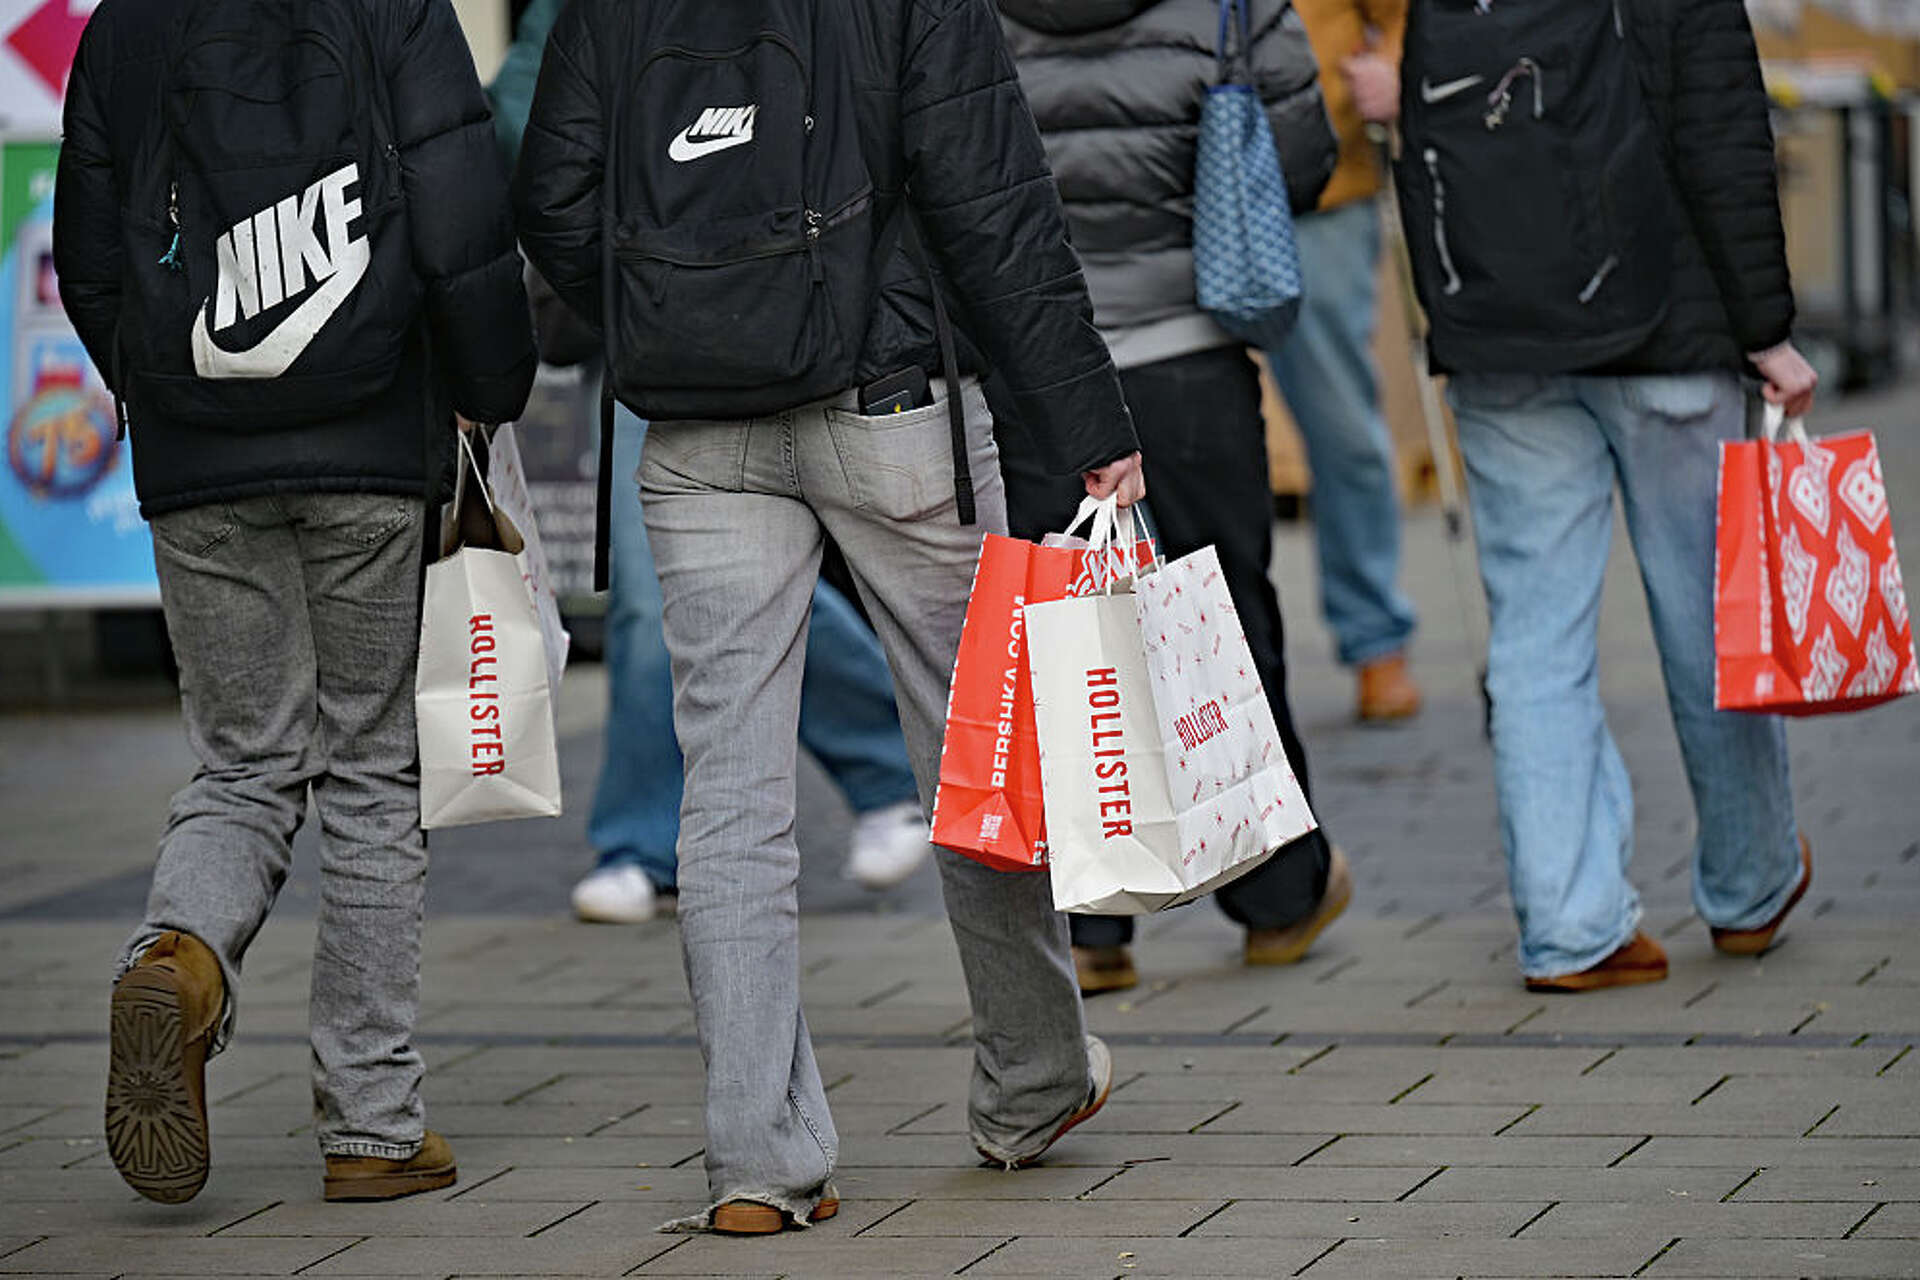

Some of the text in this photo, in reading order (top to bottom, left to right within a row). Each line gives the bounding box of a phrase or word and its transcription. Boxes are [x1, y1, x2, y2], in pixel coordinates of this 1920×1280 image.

[214, 162, 369, 332] NIKE
[468, 614, 505, 777] HOLLISTER
[1086, 667, 1133, 840] HOLLISTER
